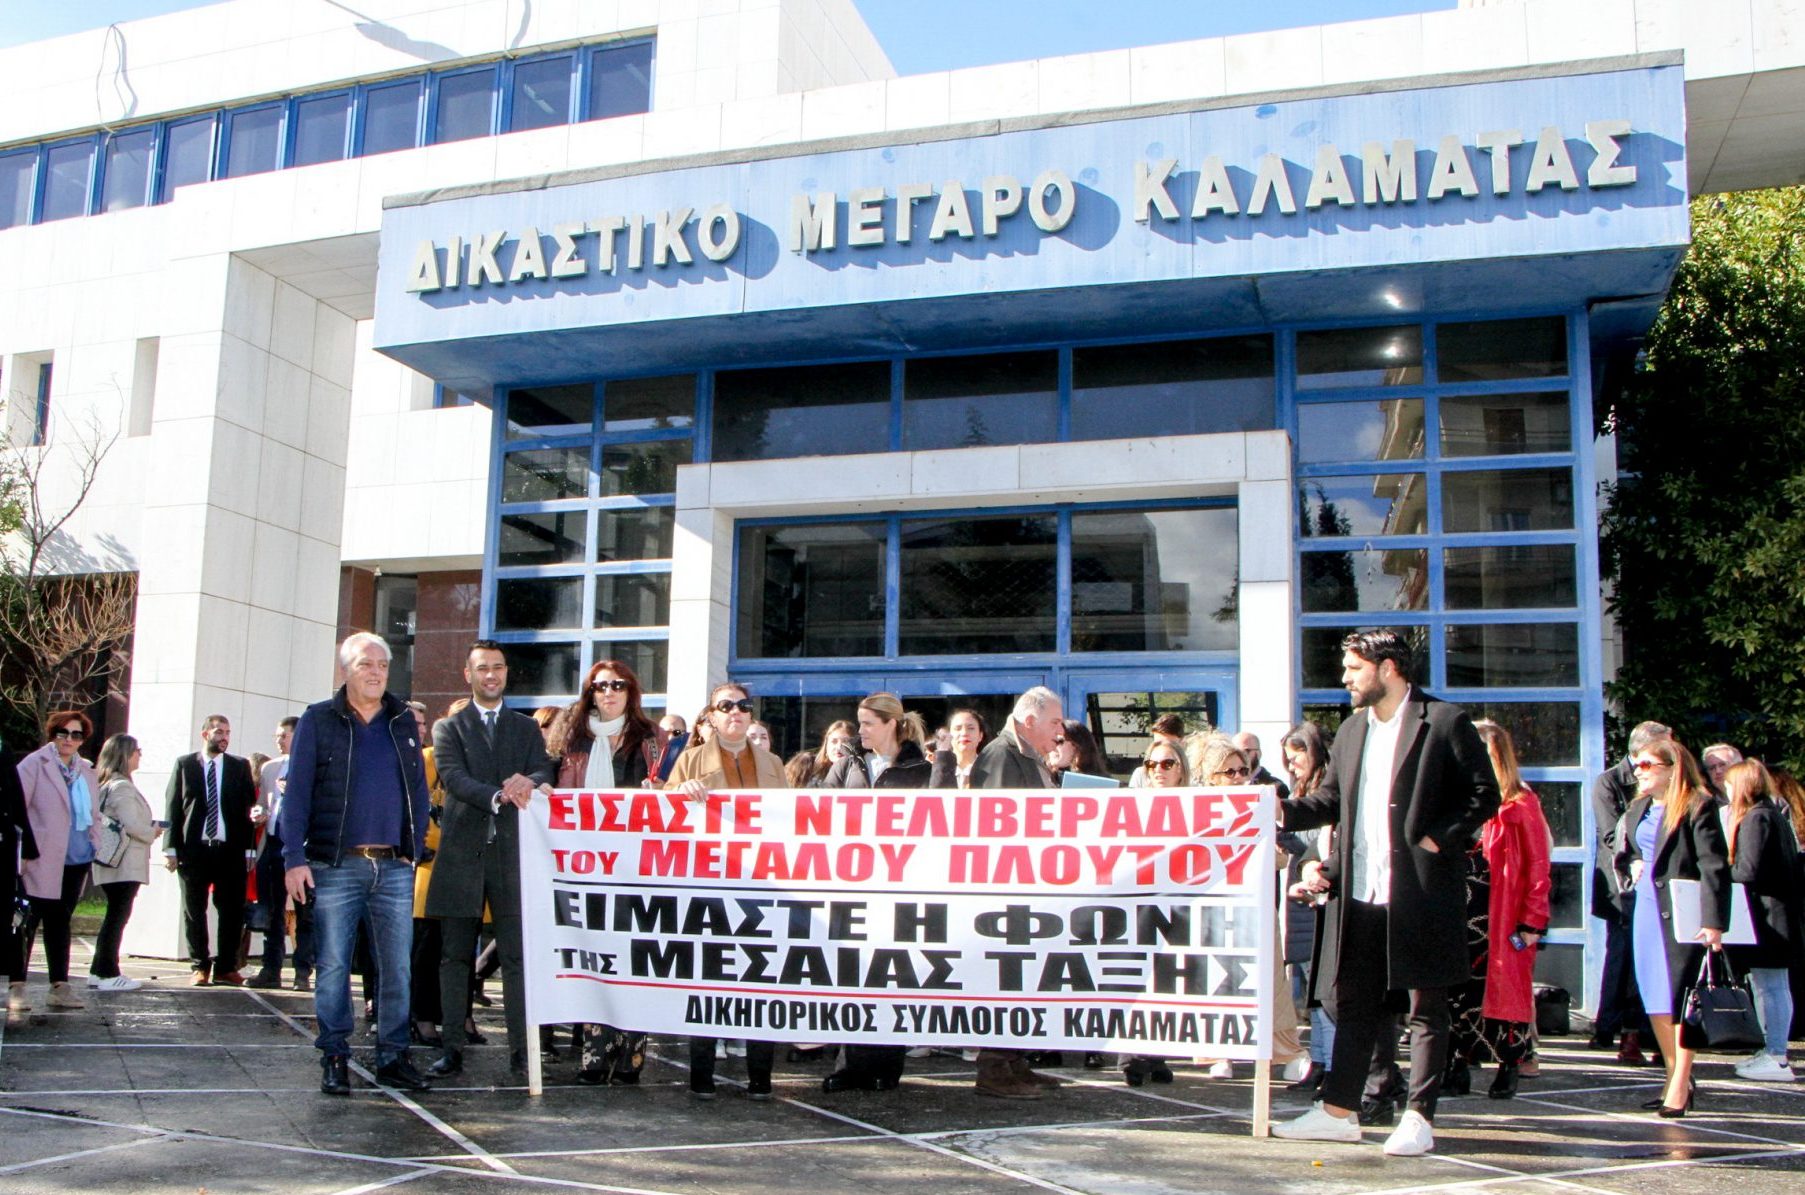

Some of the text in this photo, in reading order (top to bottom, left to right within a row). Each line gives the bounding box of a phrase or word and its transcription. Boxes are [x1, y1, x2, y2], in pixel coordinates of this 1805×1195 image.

[406, 121, 1638, 293] ΔΙΚΑΣΤΙΚΟ ΜΕΓΑΡΟ ΚΑΛΑΜΑΤΑΣ
[549, 793, 1260, 838] ΕΙΣΑΣΤΕ ΝΤΕΛΙΒΕΡΑΔΕΣ
[552, 839, 1257, 885] ΤΟΥ ΜΕΓΑΛΟΥ ΠΛΟΥΤΟΥ
[554, 889, 1259, 948] ΕΙΜΑΣΤΕ Η ΦΩΝΗ
[554, 939, 1257, 997] ΤΗΣ ΜΕΣΑΙΑΣ ΤΑΞΗΣ
[685, 995, 1258, 1046] ΔΙΚΗΓΟΡΙΚΟΣ ΣΥΛΛΟΓΟΣ ΚΑΛΑΜΑΤΑΣ
